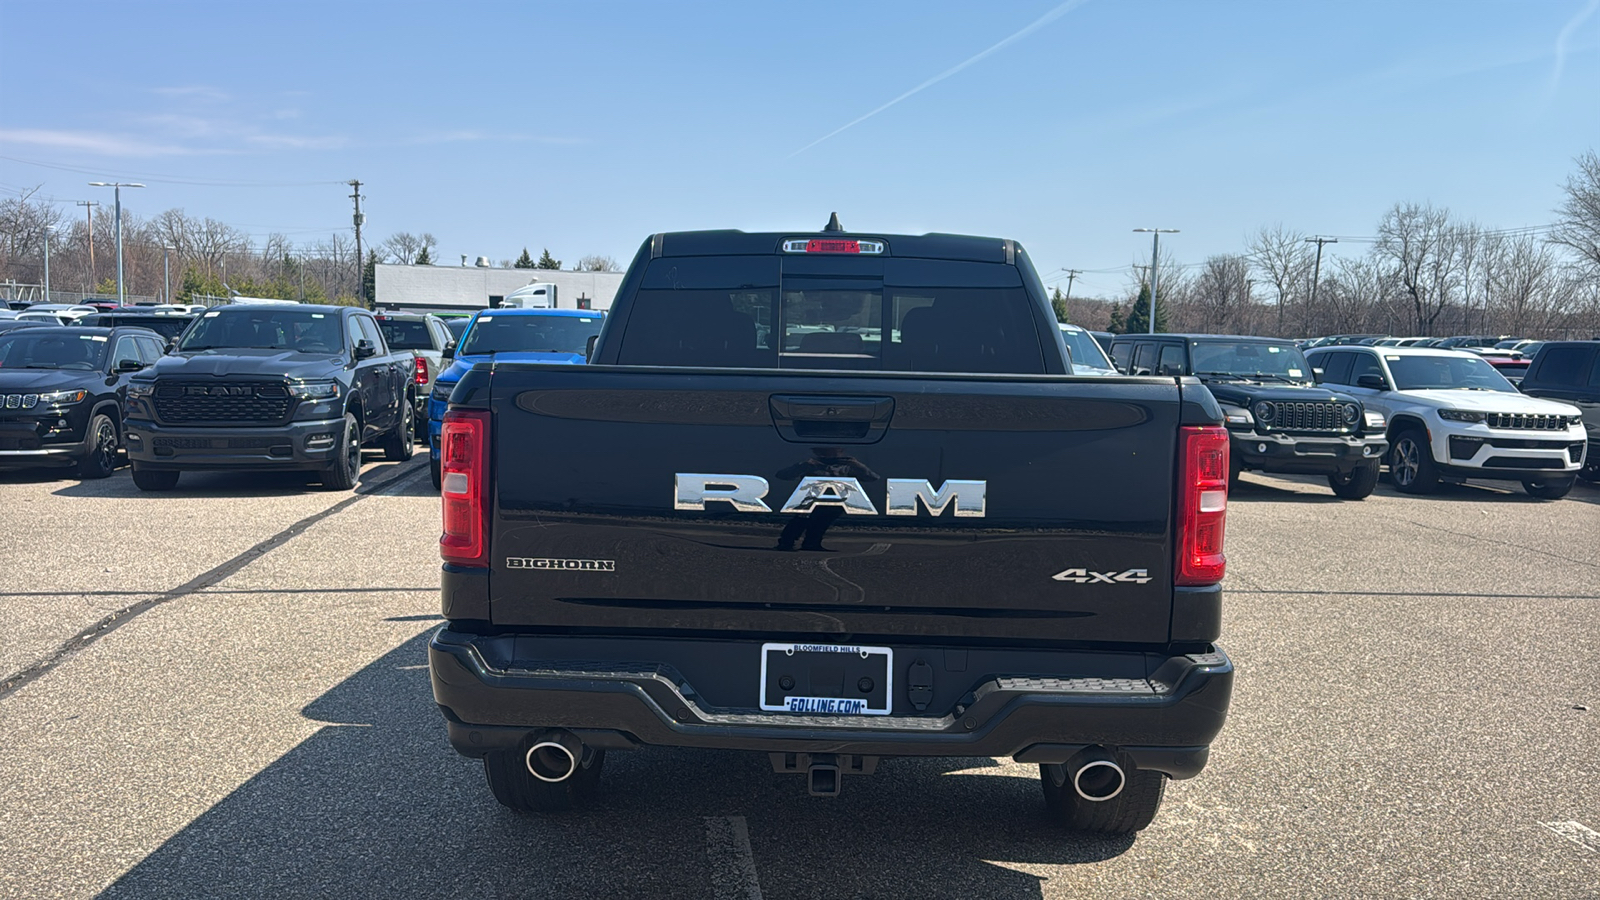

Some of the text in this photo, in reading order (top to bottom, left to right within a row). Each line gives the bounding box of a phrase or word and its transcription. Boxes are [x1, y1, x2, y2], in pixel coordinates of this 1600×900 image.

[187, 386, 252, 397] RAM
[674, 473, 987, 518] RAM
[506, 557, 615, 571] BIGHORN
[1051, 568, 1153, 584] 4x4
[794, 645, 839, 653] BLOOMFIELD
[790, 698, 862, 714] GOLLING.COM
